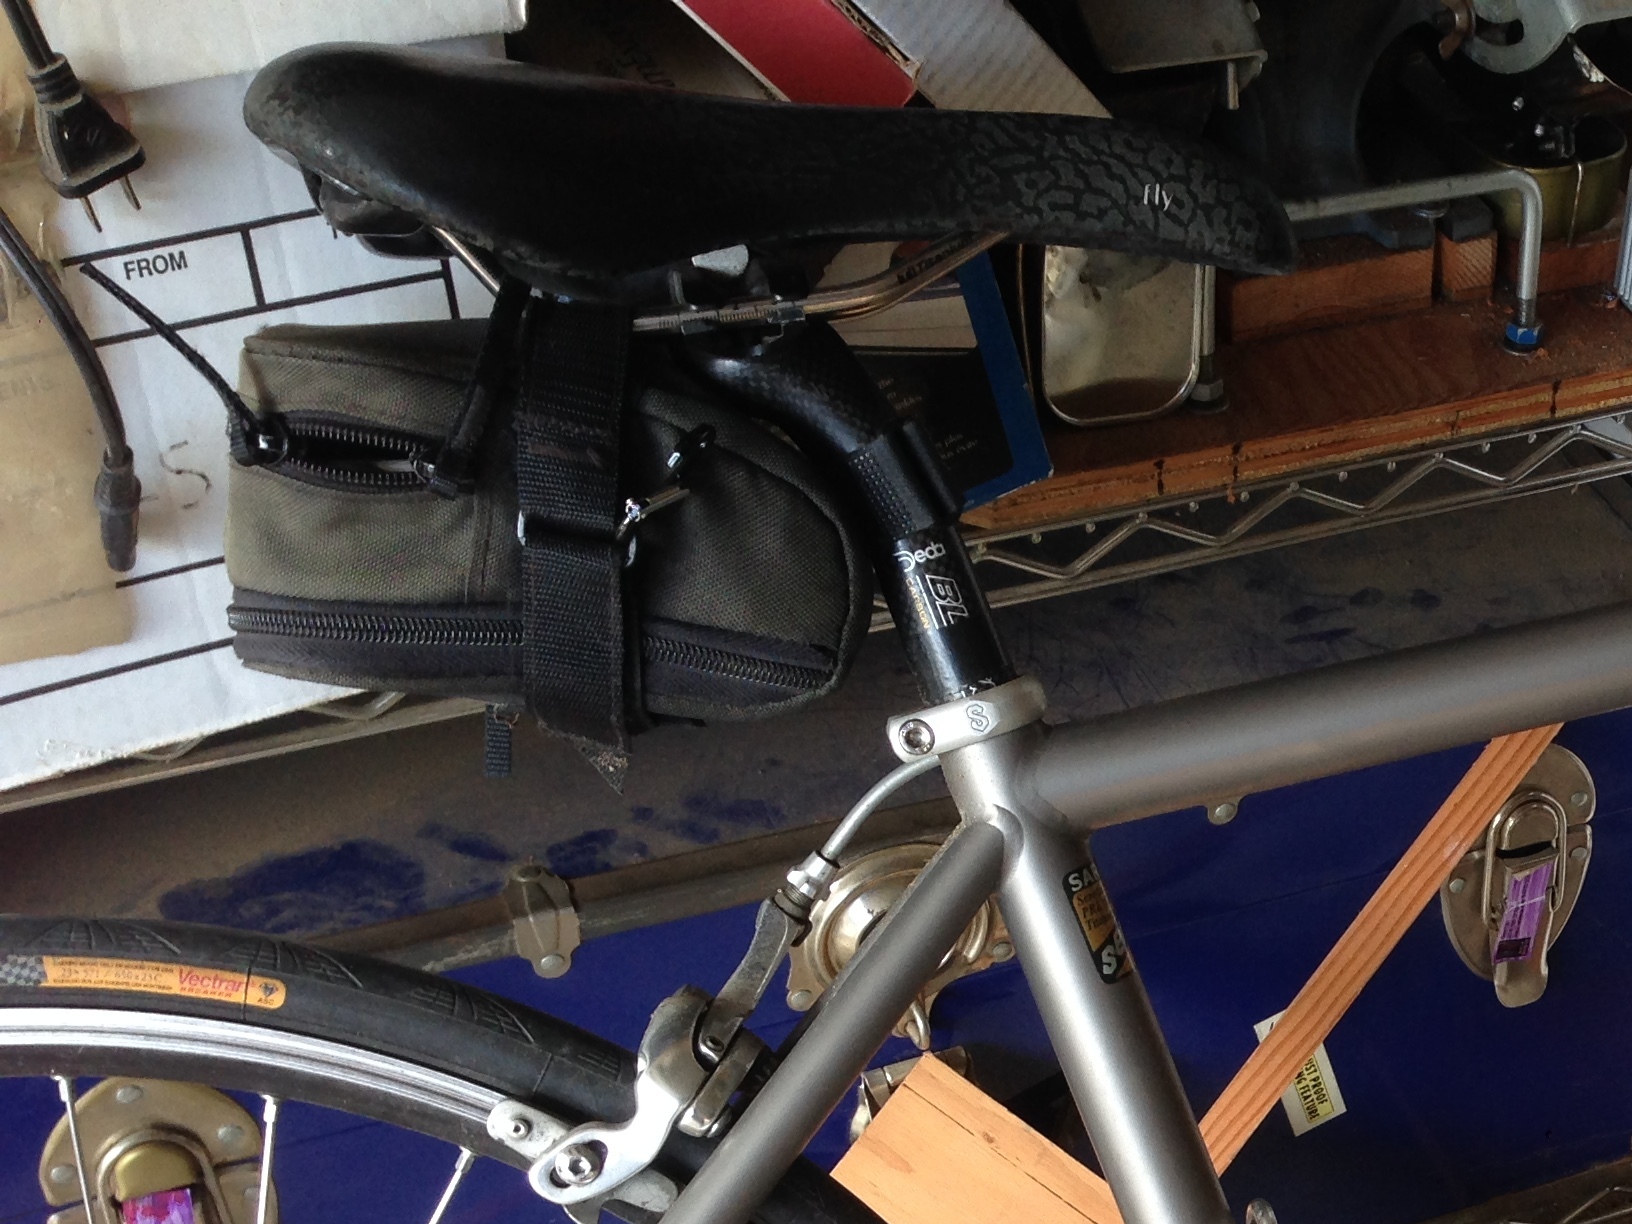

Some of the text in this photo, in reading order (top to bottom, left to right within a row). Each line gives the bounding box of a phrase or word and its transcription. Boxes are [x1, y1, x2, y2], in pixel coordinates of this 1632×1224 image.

[123, 250, 189, 280] FROM
[1299, 1081, 1320, 1121] FEATURE
[1309, 1076, 1328, 1105] PROOF
